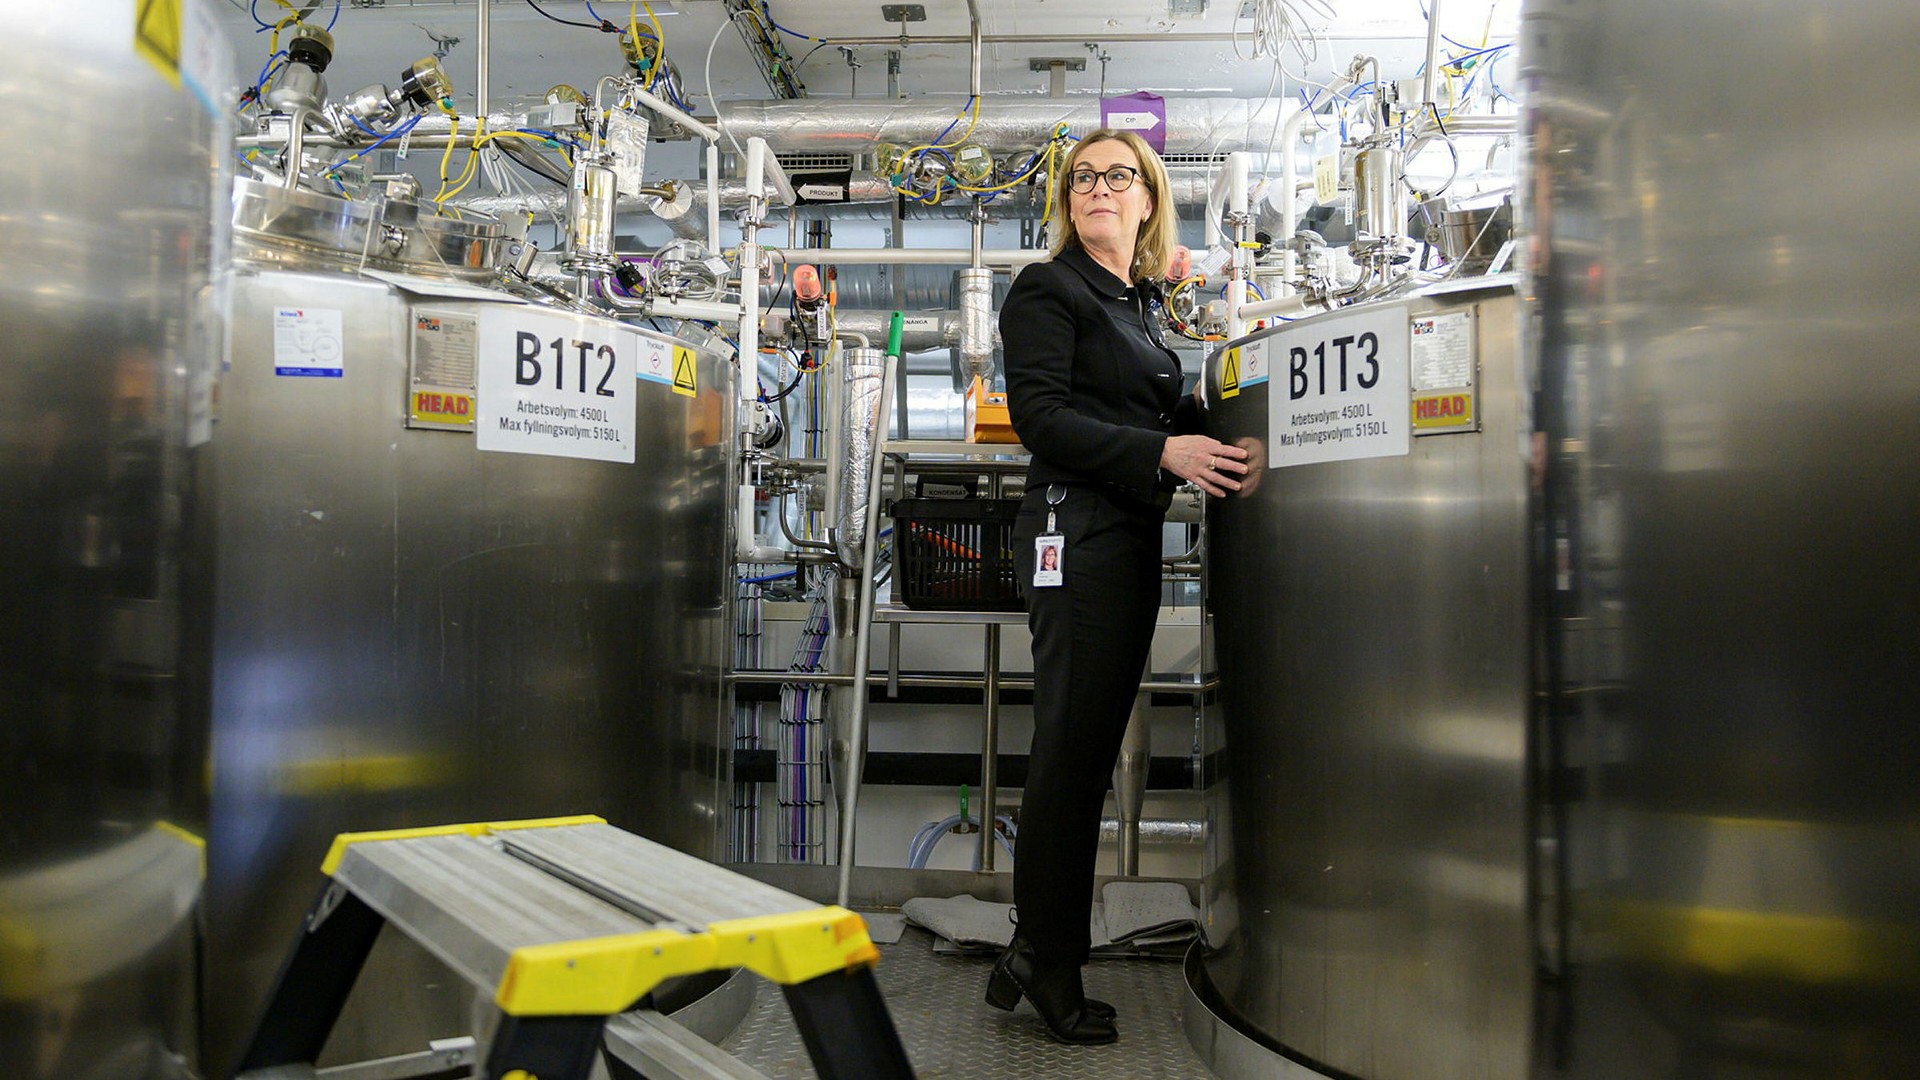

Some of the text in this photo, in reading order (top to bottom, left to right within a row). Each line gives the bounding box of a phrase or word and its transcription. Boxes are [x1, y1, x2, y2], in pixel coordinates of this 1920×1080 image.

[516, 331, 616, 398] B1T2
[1290, 331, 1380, 400] B1T3
[417, 393, 469, 415] HEAD
[517, 400, 608, 423] Arbetsvolym: 4500 L
[1291, 403, 1373, 427] Arbetsvolym: 4500 L
[1415, 396, 1466, 420] HEAD
[500, 417, 620, 442] Max fyllningsvolym: 5150 L
[1281, 421, 1388, 447] Max fyllningsvolym: 5150 L
